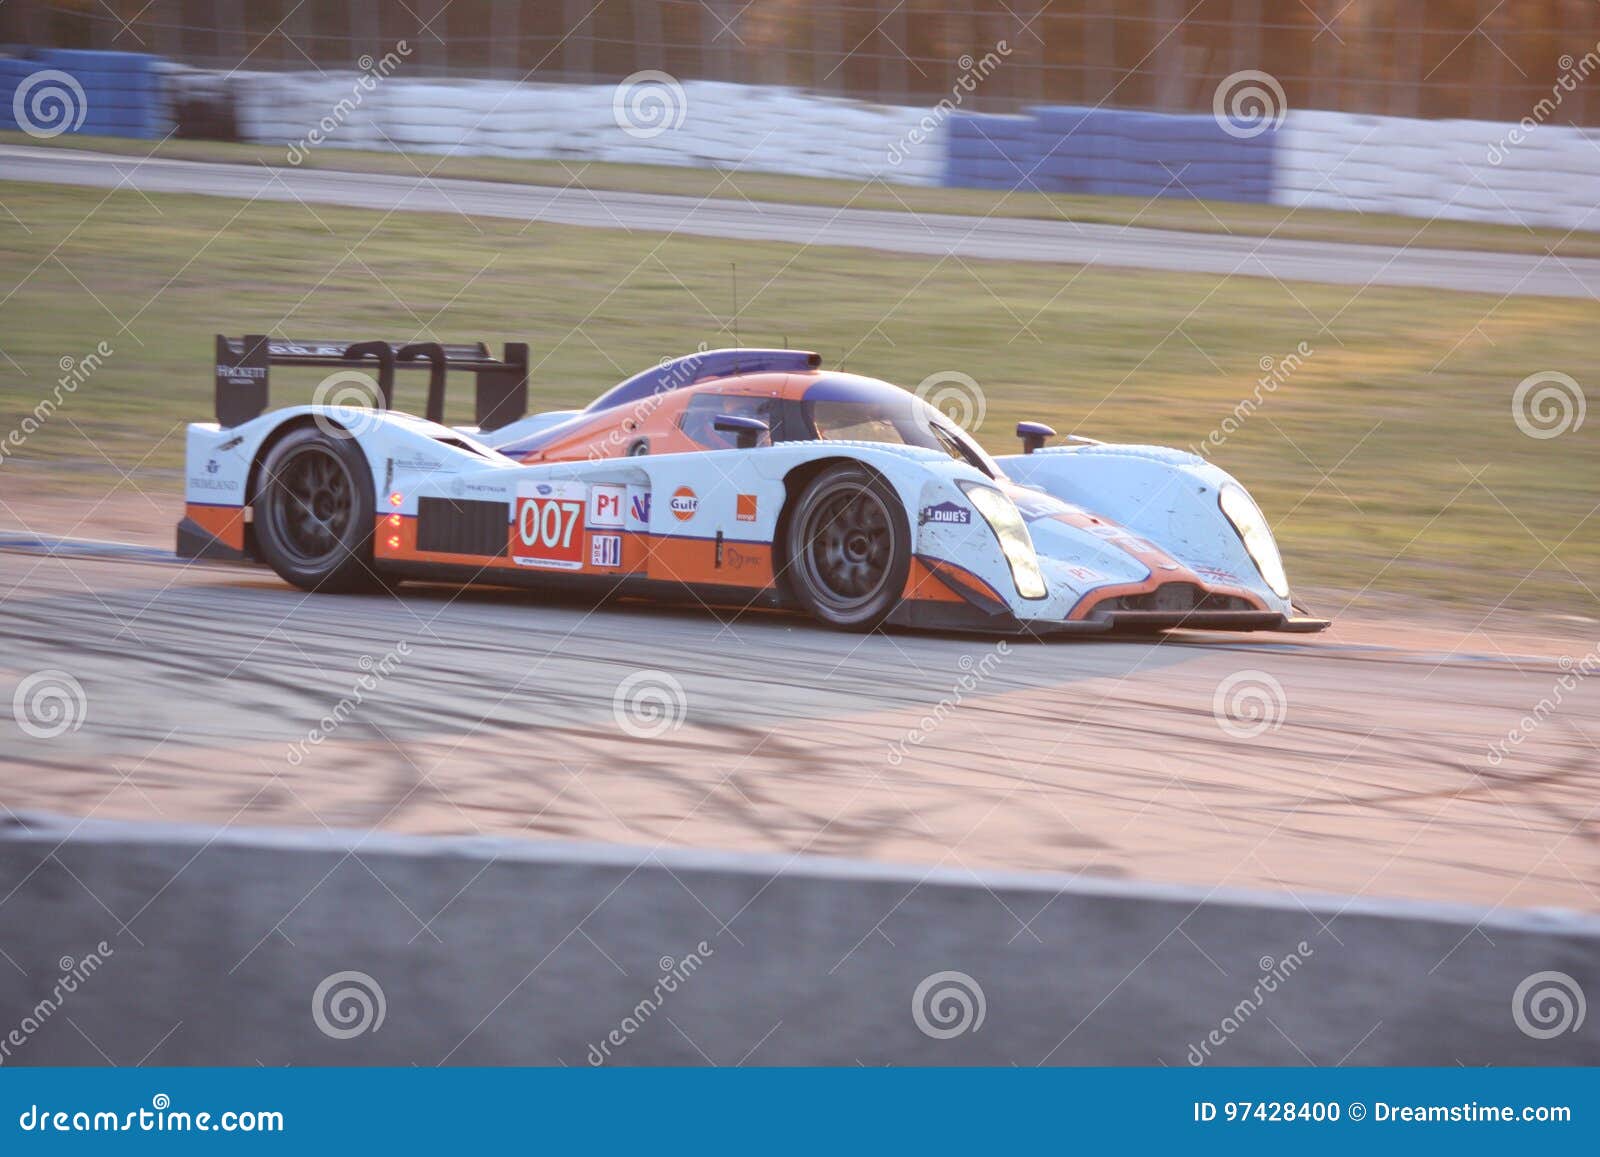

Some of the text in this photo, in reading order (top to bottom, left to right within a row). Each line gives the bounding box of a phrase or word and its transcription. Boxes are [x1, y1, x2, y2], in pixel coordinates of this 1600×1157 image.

[597, 495, 618, 516] P1
[670, 498, 698, 510] Gulf
[520, 499, 580, 548] 007
[928, 508, 969, 522] LOWE'S
